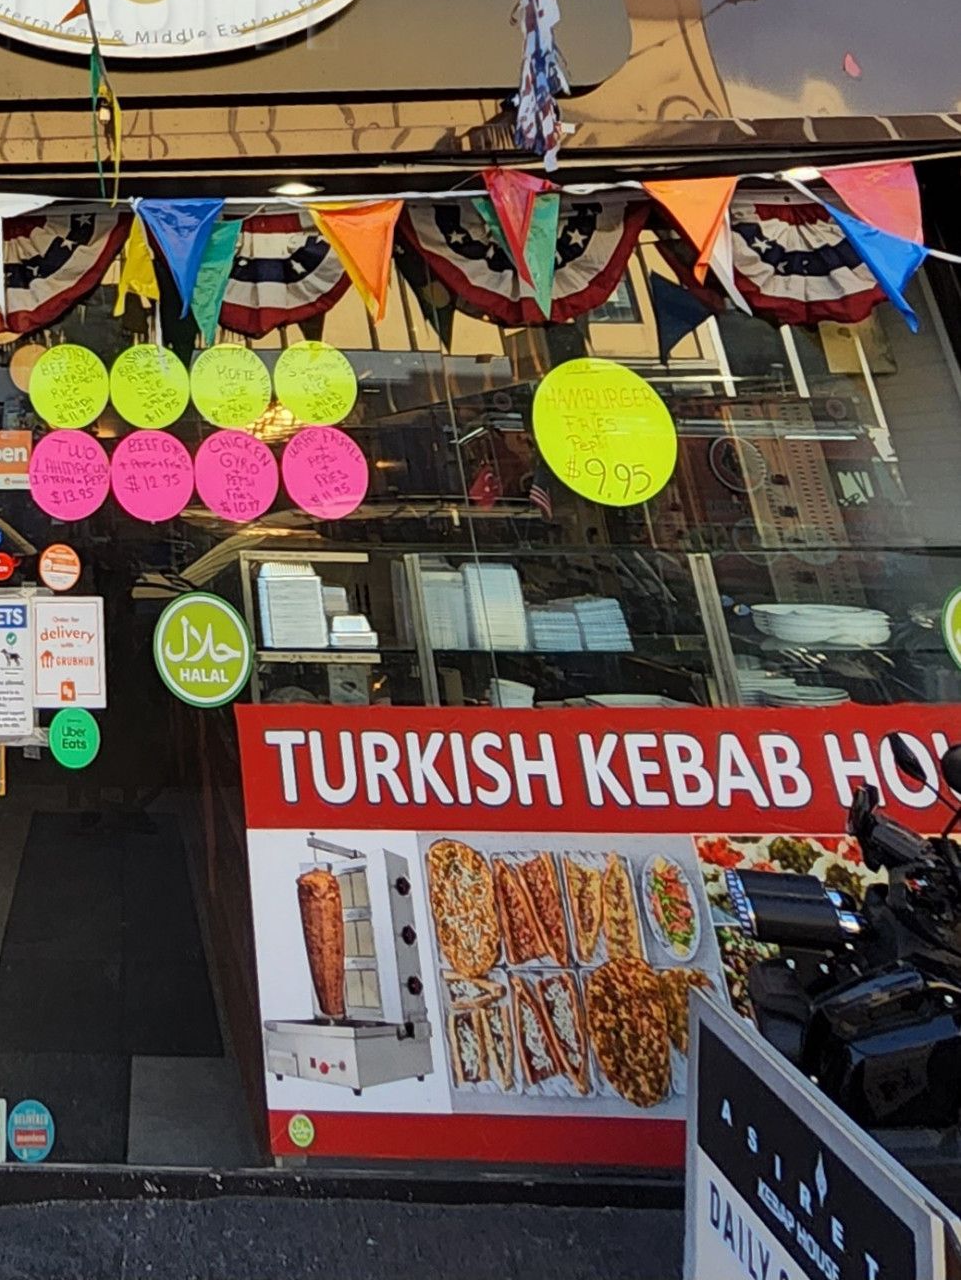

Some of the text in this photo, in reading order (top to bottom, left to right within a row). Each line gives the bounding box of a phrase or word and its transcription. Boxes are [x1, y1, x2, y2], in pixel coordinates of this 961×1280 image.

[112, 29, 124, 42] &
[135, 29, 208, 45] Middle
[216, 8, 291, 38] Eastern
[545, 387, 659, 412] HAMBURGER
[51, 438, 98, 460] TWO
[208, 436, 271, 467] CHICKEN
[219, 452, 260, 475] GYRO
[40, 625, 95, 643] delivery
[164, 614, 242, 663] حلال
[56, 656, 95, 667] GRUBHUB
[180, 668, 229, 684] HALAL
[62, 725, 86, 738] Uber
[62, 738, 87, 750] Eats
[264, 729, 563, 808] TURKISH
[578, 730, 813, 811] KEBAB
[710, 1180, 771, 1280] DAILY
